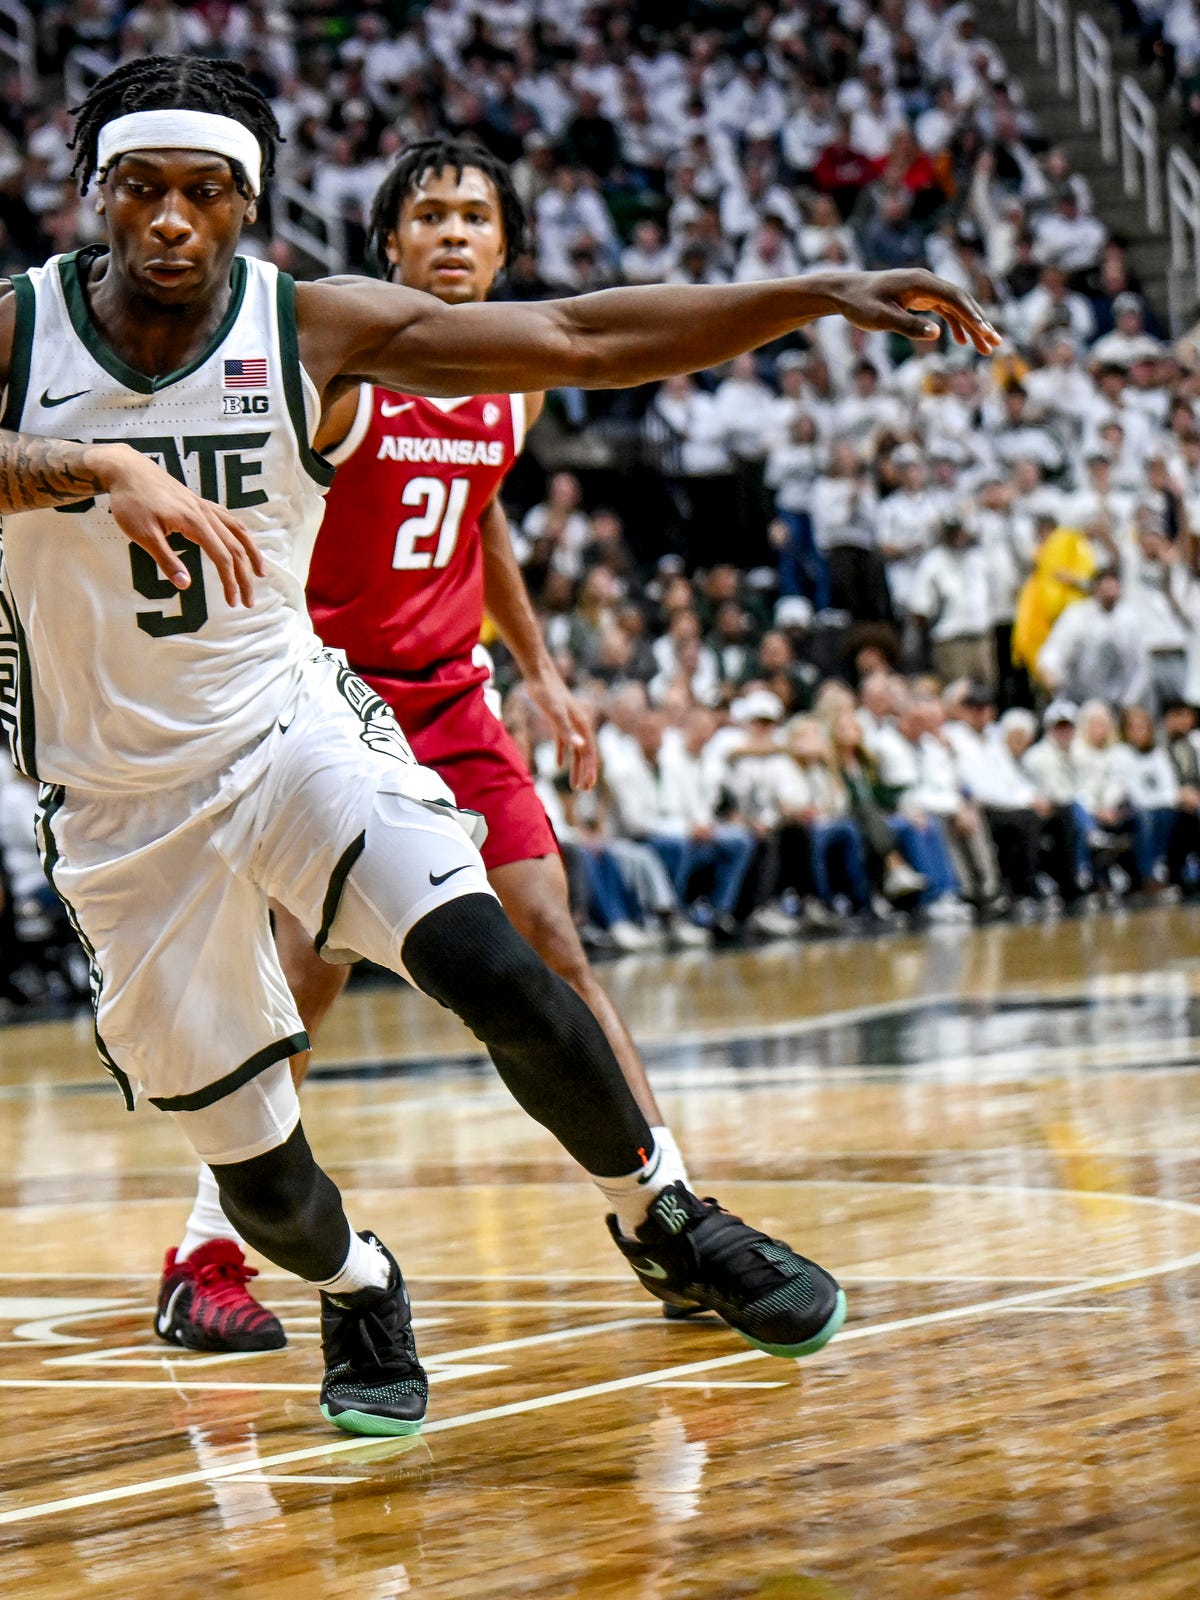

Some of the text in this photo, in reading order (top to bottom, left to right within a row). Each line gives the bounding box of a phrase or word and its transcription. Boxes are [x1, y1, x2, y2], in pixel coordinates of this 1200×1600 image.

[377, 435, 504, 467] ARKANSAS
[392, 476, 470, 570] 21
[128, 531, 209, 638] 9
